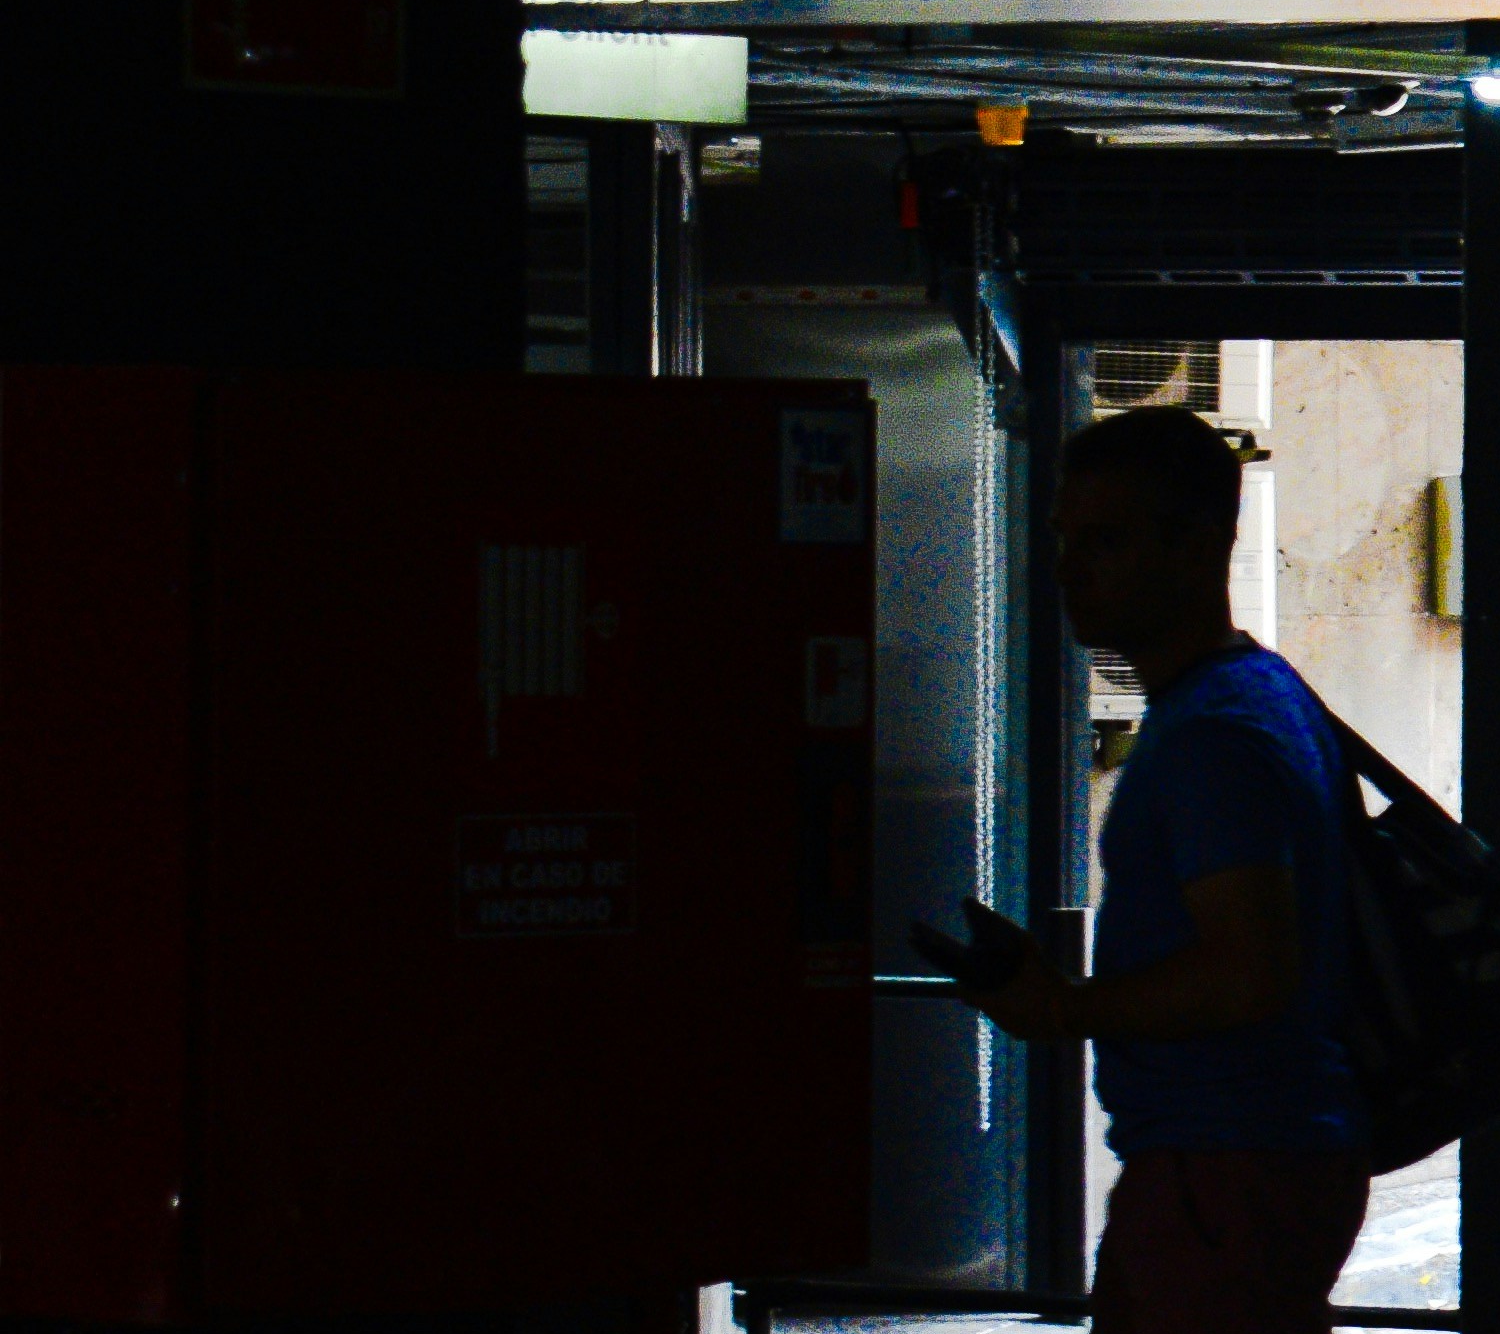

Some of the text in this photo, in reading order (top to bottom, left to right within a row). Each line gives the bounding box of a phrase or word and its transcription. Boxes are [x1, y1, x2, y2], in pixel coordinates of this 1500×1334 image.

[504, 824, 588, 852] ABRIR
[464, 859, 626, 890] EN CASO DE
[478, 897, 612, 924] INCENDIO
